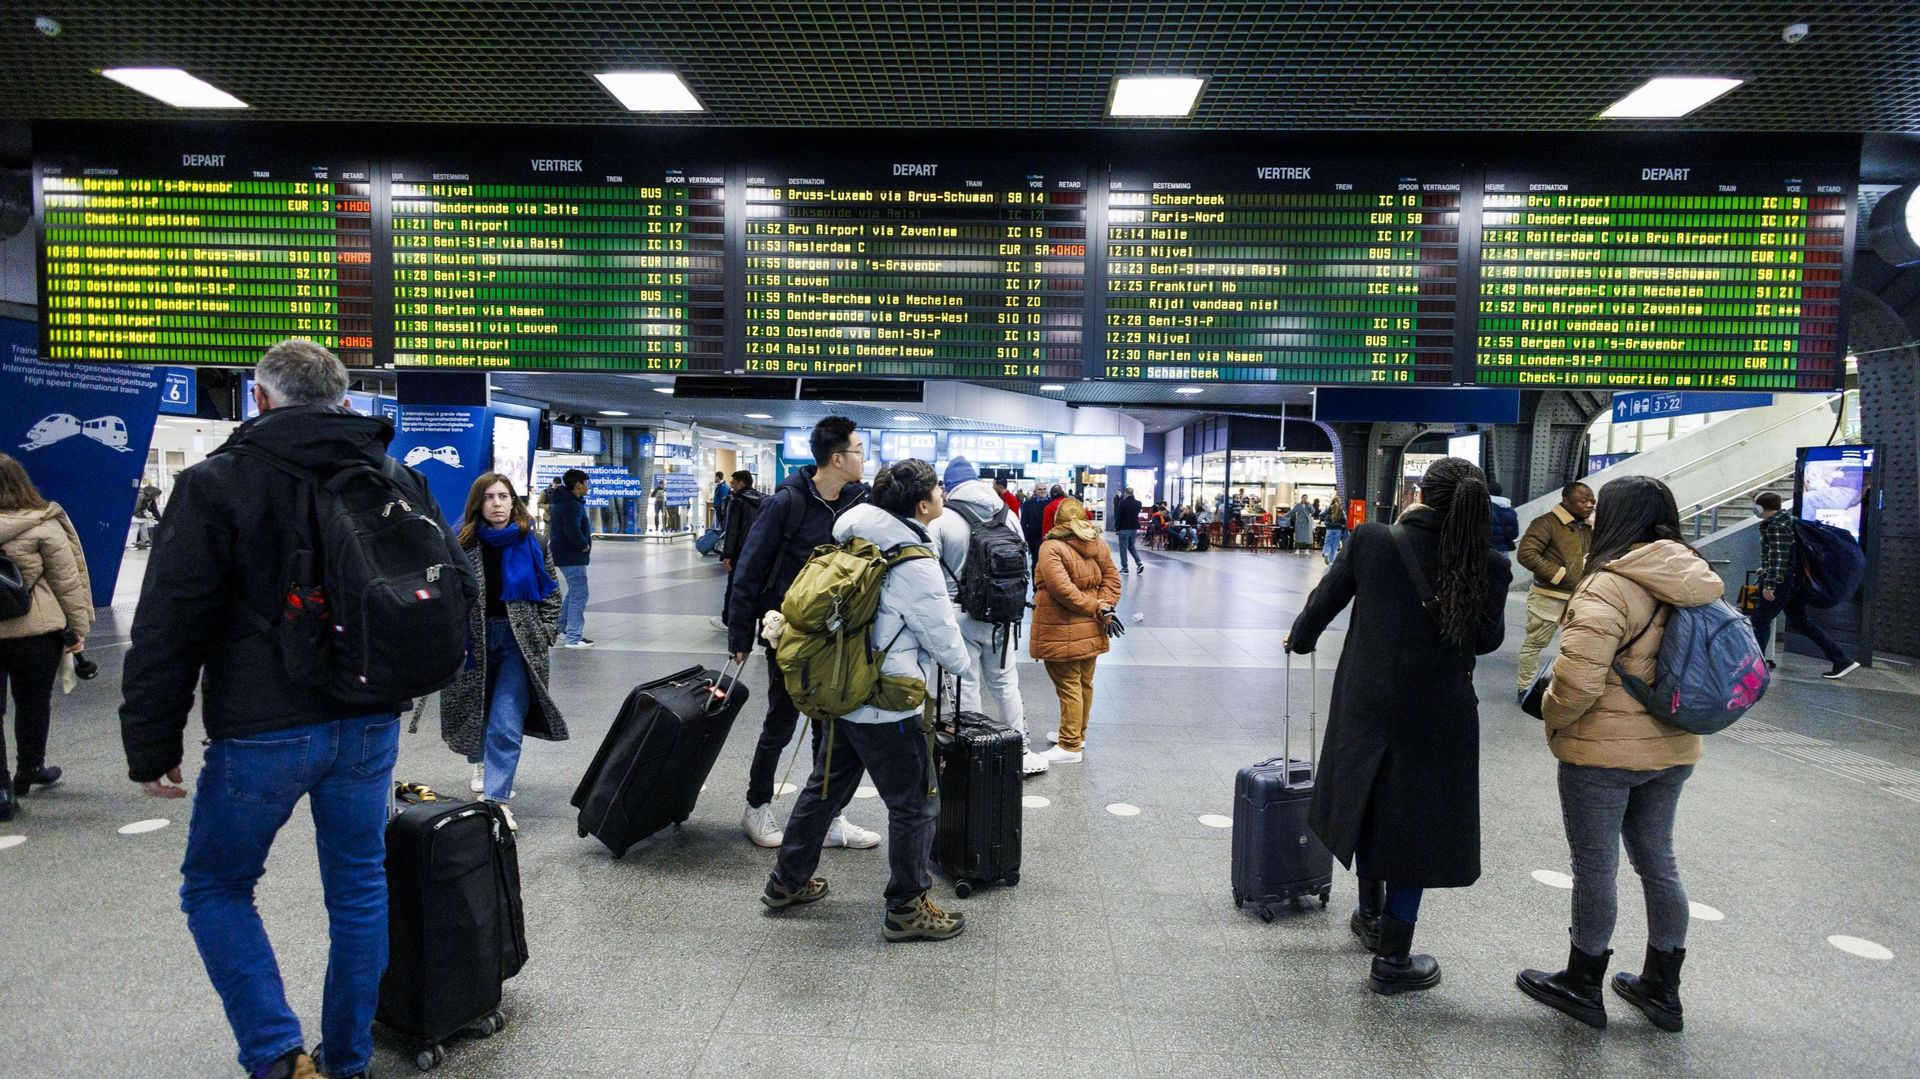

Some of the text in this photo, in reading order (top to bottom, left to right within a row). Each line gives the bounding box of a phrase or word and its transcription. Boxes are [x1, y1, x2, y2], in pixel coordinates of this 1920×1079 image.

[183, 154, 225, 167] DEPART
[532, 160, 582, 172] VERTREK
[893, 164, 937, 176] DEPART
[1257, 168, 1311, 179] VERTREK
[1642, 168, 1690, 181] DEPART
[1719, 184, 1736, 192] TRAIN
[880, 192, 900, 201] via
[1030, 193, 1044, 203] 14
[1152, 194, 1223, 204] Schaarbeek
[1379, 196, 1394, 206] IC
[1401, 196, 1415, 206] 16
[1152, 212, 1223, 222] Paris-Nord
[1371, 213, 1393, 223] EUR
[1407, 213, 1422, 224] 5B
[393, 218, 682, 233] 11:21 Bru Airport IC 17
[747, 224, 1043, 237] 11:52 Bru Airport via Zaventem IC 15
[1109, 228, 1414, 241] 12:14 Halle IC 17
[1483, 231, 1797, 245] 12:42 Rotterdam C via Bru Airport EC 11
[393, 236, 682, 250] 11:23 Gent-St-P via Aalst IC 13
[747, 241, 781, 251] 11:53
[788, 242, 851, 252] Amsterdam
[858, 243, 865, 252] C
[1000, 245, 1021, 254] EUR
[1035, 245, 1050, 255] 5A
[1480, 284, 1517, 294] 12:49
[1613, 286, 1635, 296] via
[1643, 286, 1702, 297] Mechelen
[1757, 287, 1771, 298] S1
[1779, 287, 1793, 298] 21
[394, 304, 682, 318] 11:30 Aarlen via Namen IC 16
[1149, 299, 1277, 310] Rijdt vandaag niet
[11, 345, 37, 355] Trains
[1106, 350, 1409, 363] 12:30 Aarlen via Namen IC 17
[1477, 354, 1789, 369] 12:56 Londen-St-P EUR 1
[3, 364, 59, 376] Internationale
[24, 376, 139, 394] High speed international trains
[1519, 373, 1734, 385] Check-in nu voorzien om 11:45
[170, 384, 180, 400] 6
[1655, 398, 1680, 411] 3 22
[590, 478, 640, 486] verbindingen
[594, 488, 641, 496] Reiseverkehr
